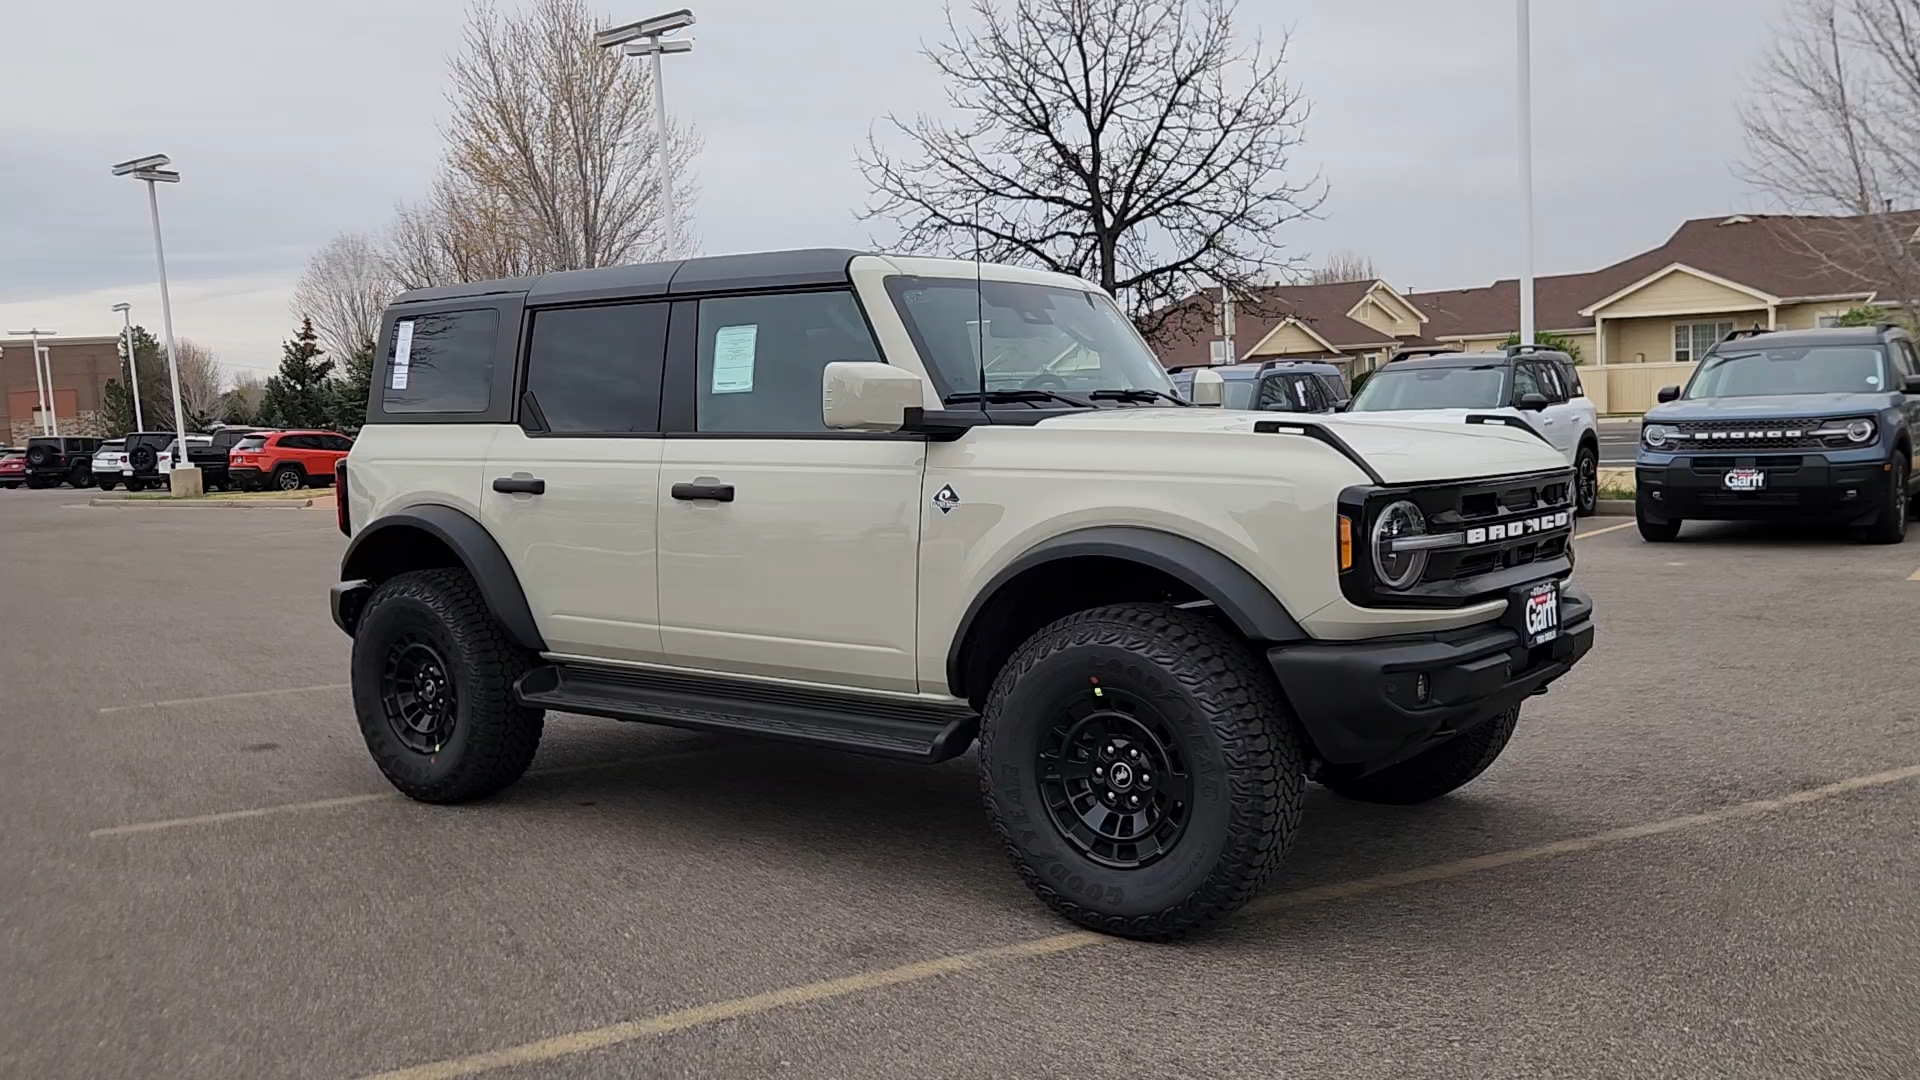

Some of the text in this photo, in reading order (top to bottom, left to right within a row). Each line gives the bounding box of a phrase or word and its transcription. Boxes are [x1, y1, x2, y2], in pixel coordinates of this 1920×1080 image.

[1695, 430, 1802, 440] BRONCO
[1724, 472, 1764, 487] Garff
[1466, 512, 1568, 544] BRONCO
[1525, 591, 1557, 635] Garff
